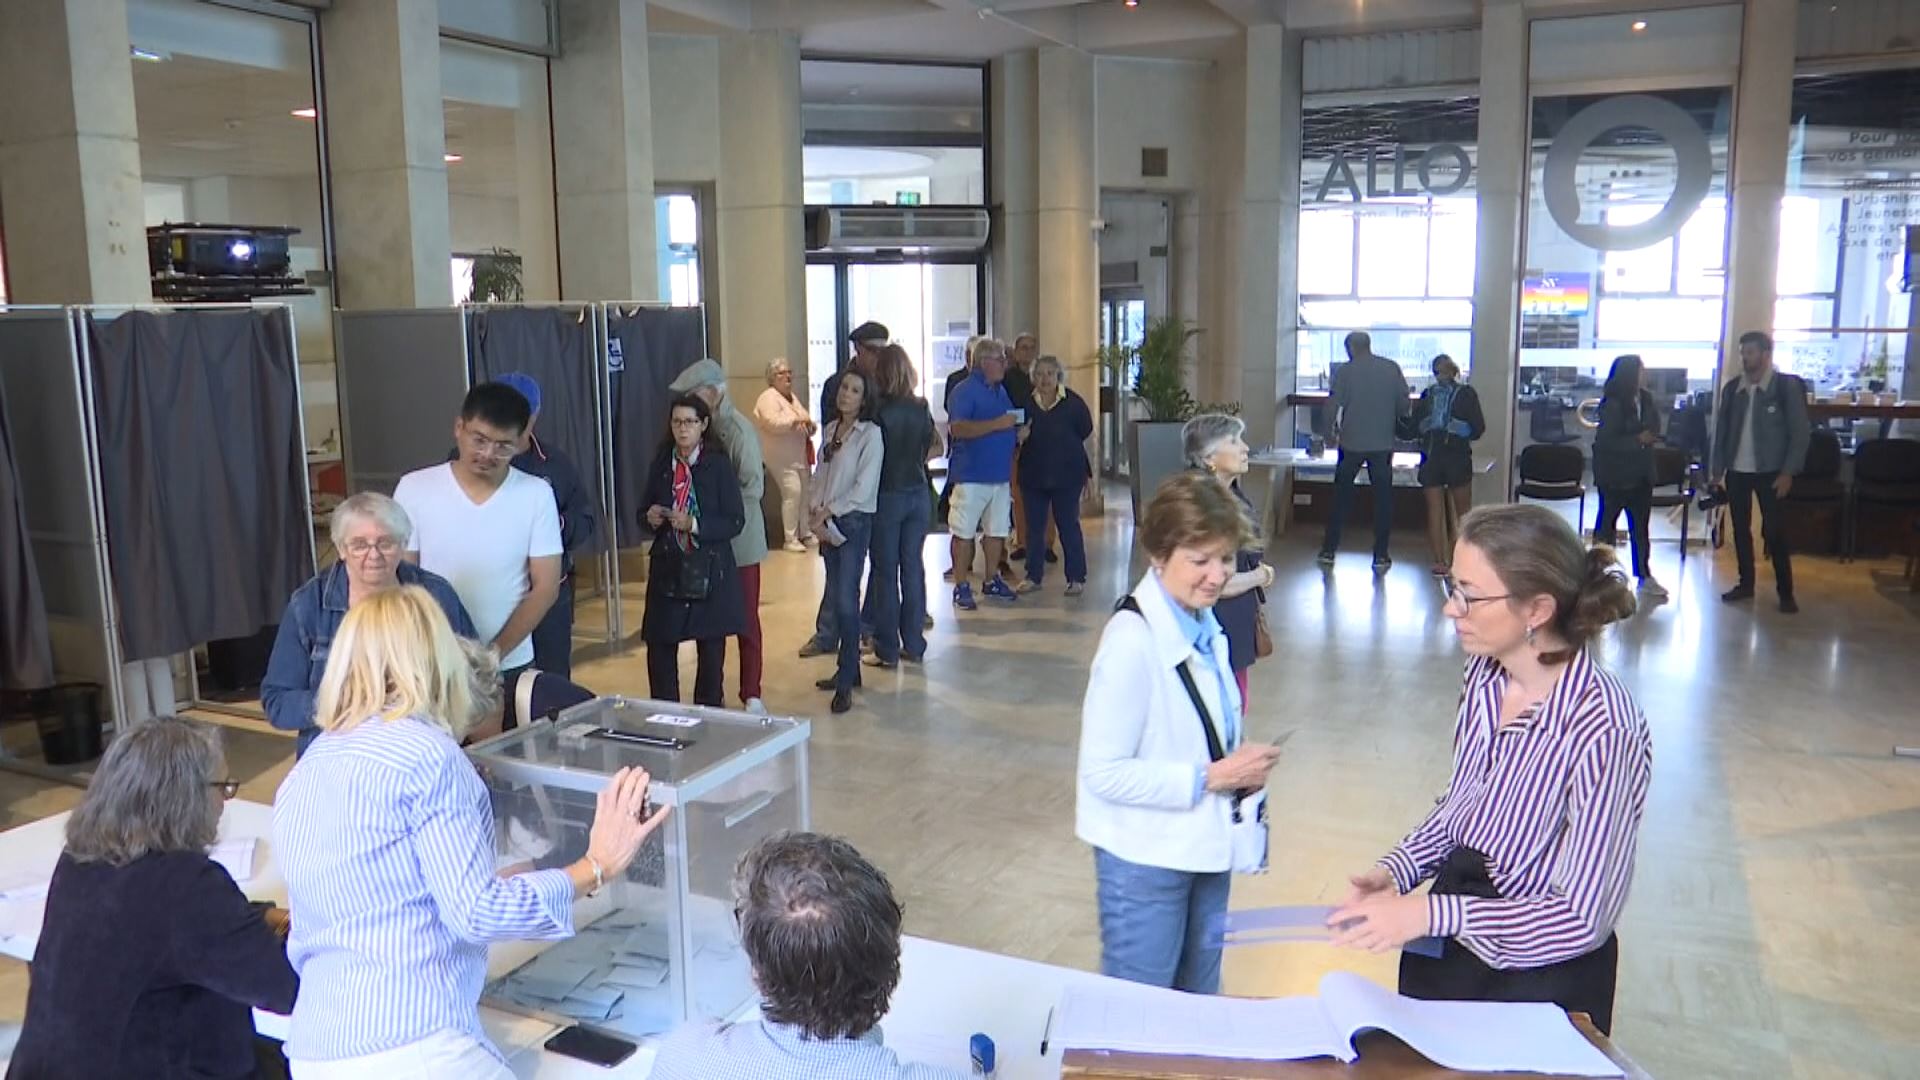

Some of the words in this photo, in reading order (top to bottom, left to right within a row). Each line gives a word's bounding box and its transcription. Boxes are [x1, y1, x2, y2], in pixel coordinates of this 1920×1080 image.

[1849, 131, 1889, 143] Pour
[1827, 151, 1857, 162] vos
[1316, 143, 1472, 203] ALLO
